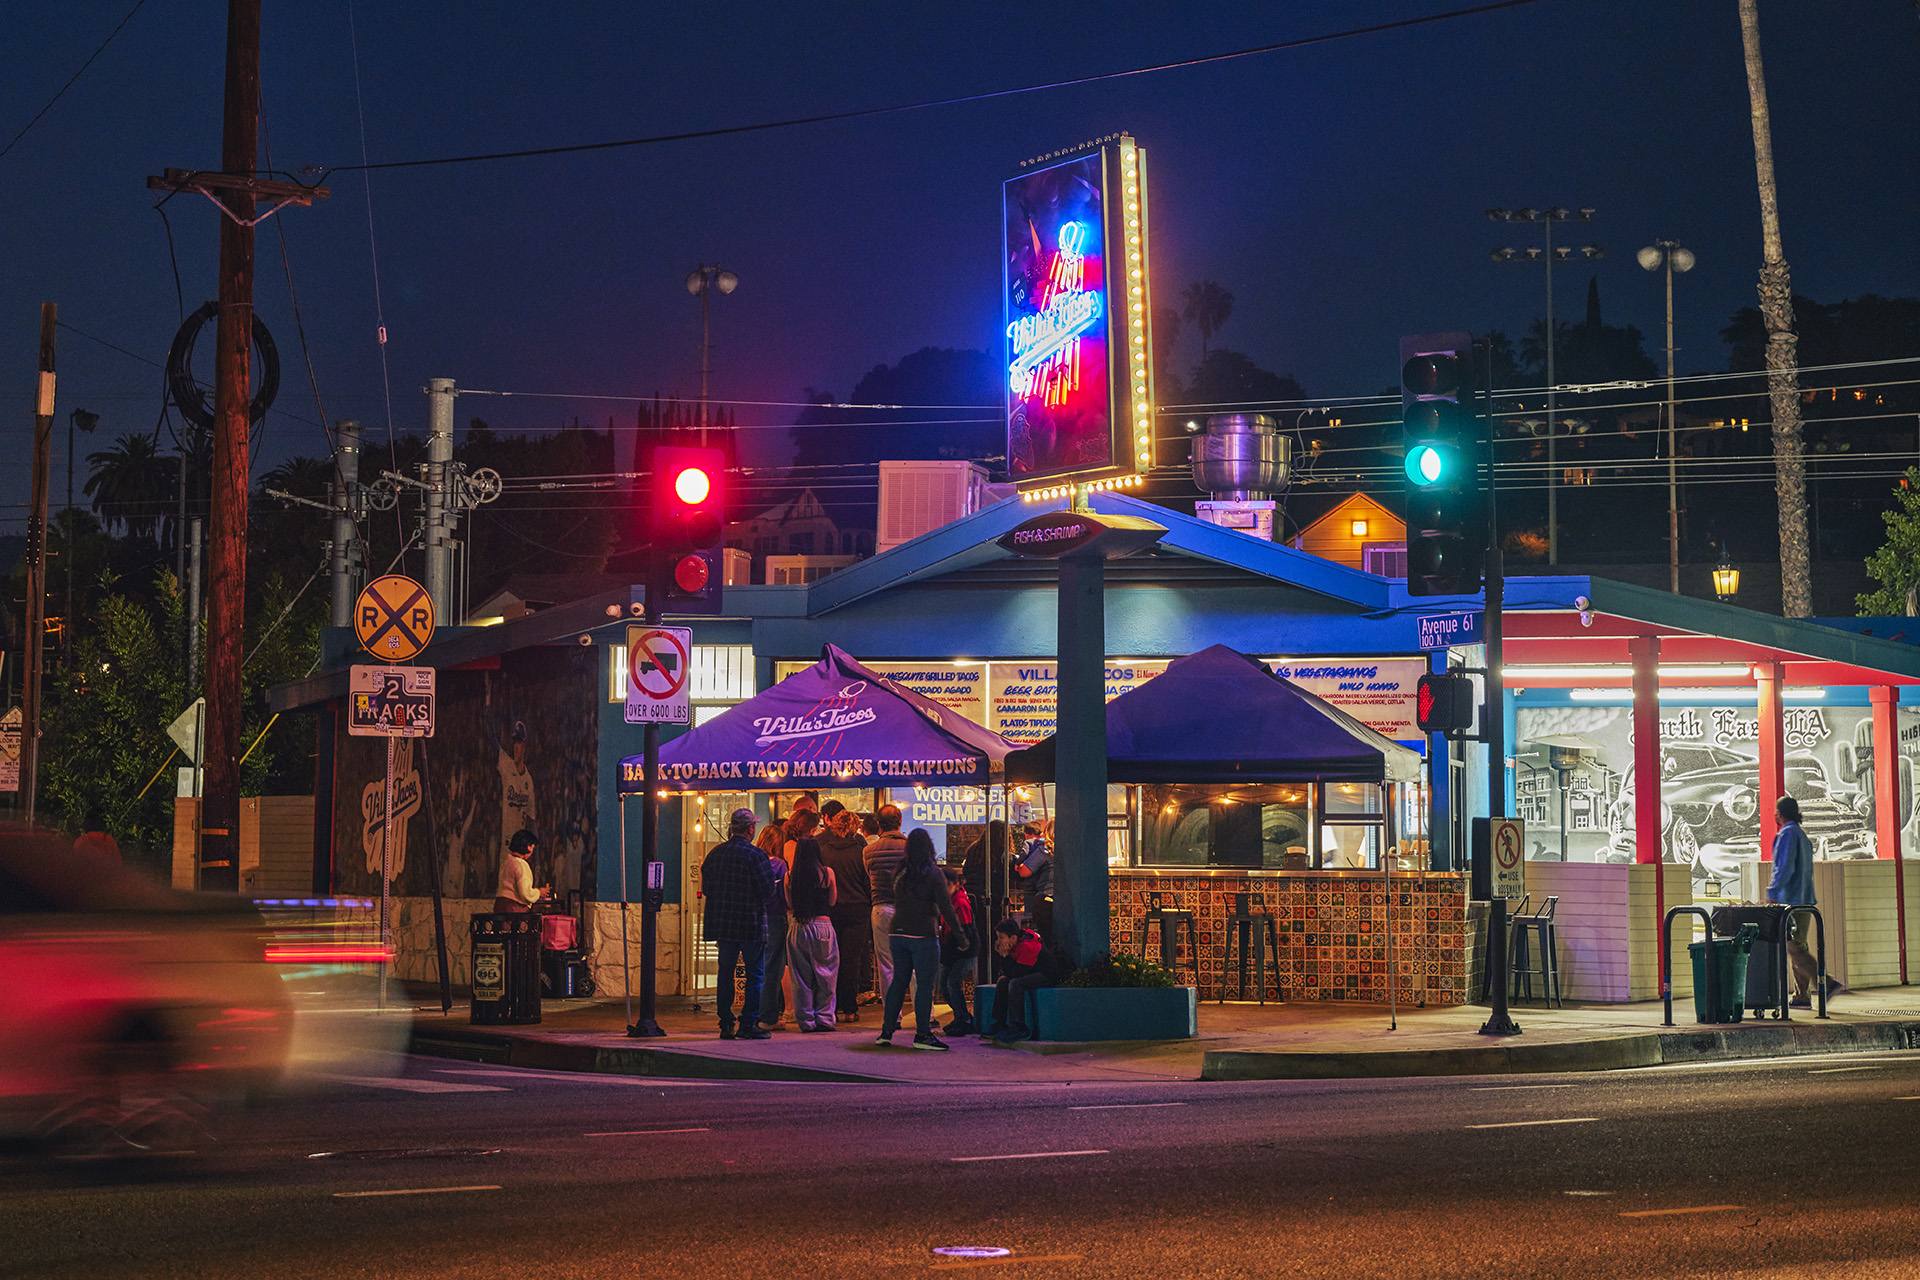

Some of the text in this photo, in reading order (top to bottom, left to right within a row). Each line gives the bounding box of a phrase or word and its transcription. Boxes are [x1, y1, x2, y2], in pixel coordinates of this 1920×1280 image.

[362, 606, 429, 630] R R
[1421, 614, 1473, 635] Avenue 61
[1421, 634, 1442, 647] 100 N
[925, 671, 956, 681] GRILLED
[956, 672, 980, 681] TACOS
[1018, 669, 1057, 680] VILL
[1105, 668, 1134, 680] COS
[1294, 665, 1379, 679] VEGETARIANOS
[386, 680, 400, 699] 2
[1004, 685, 1033, 696] BEER
[1034, 685, 1058, 696] BATT
[628, 703, 687, 719] OVER 6000 LBS
[753, 705, 874, 736] Villa's Tacos
[1000, 719, 1028, 727] PLATOS
[1711, 708, 1759, 745] Eas
[1901, 724, 1920, 741] HIG
[623, 761, 743, 781] BAK-TO-BACK
[747, 761, 789, 779] TACO
[792, 758, 872, 777] MADNESS
[877, 757, 977, 776] CHAMPIONS
[913, 787, 978, 802] WORLD
[913, 803, 1034, 824] CHAMPONS
[1507, 871, 1519, 881] USE
